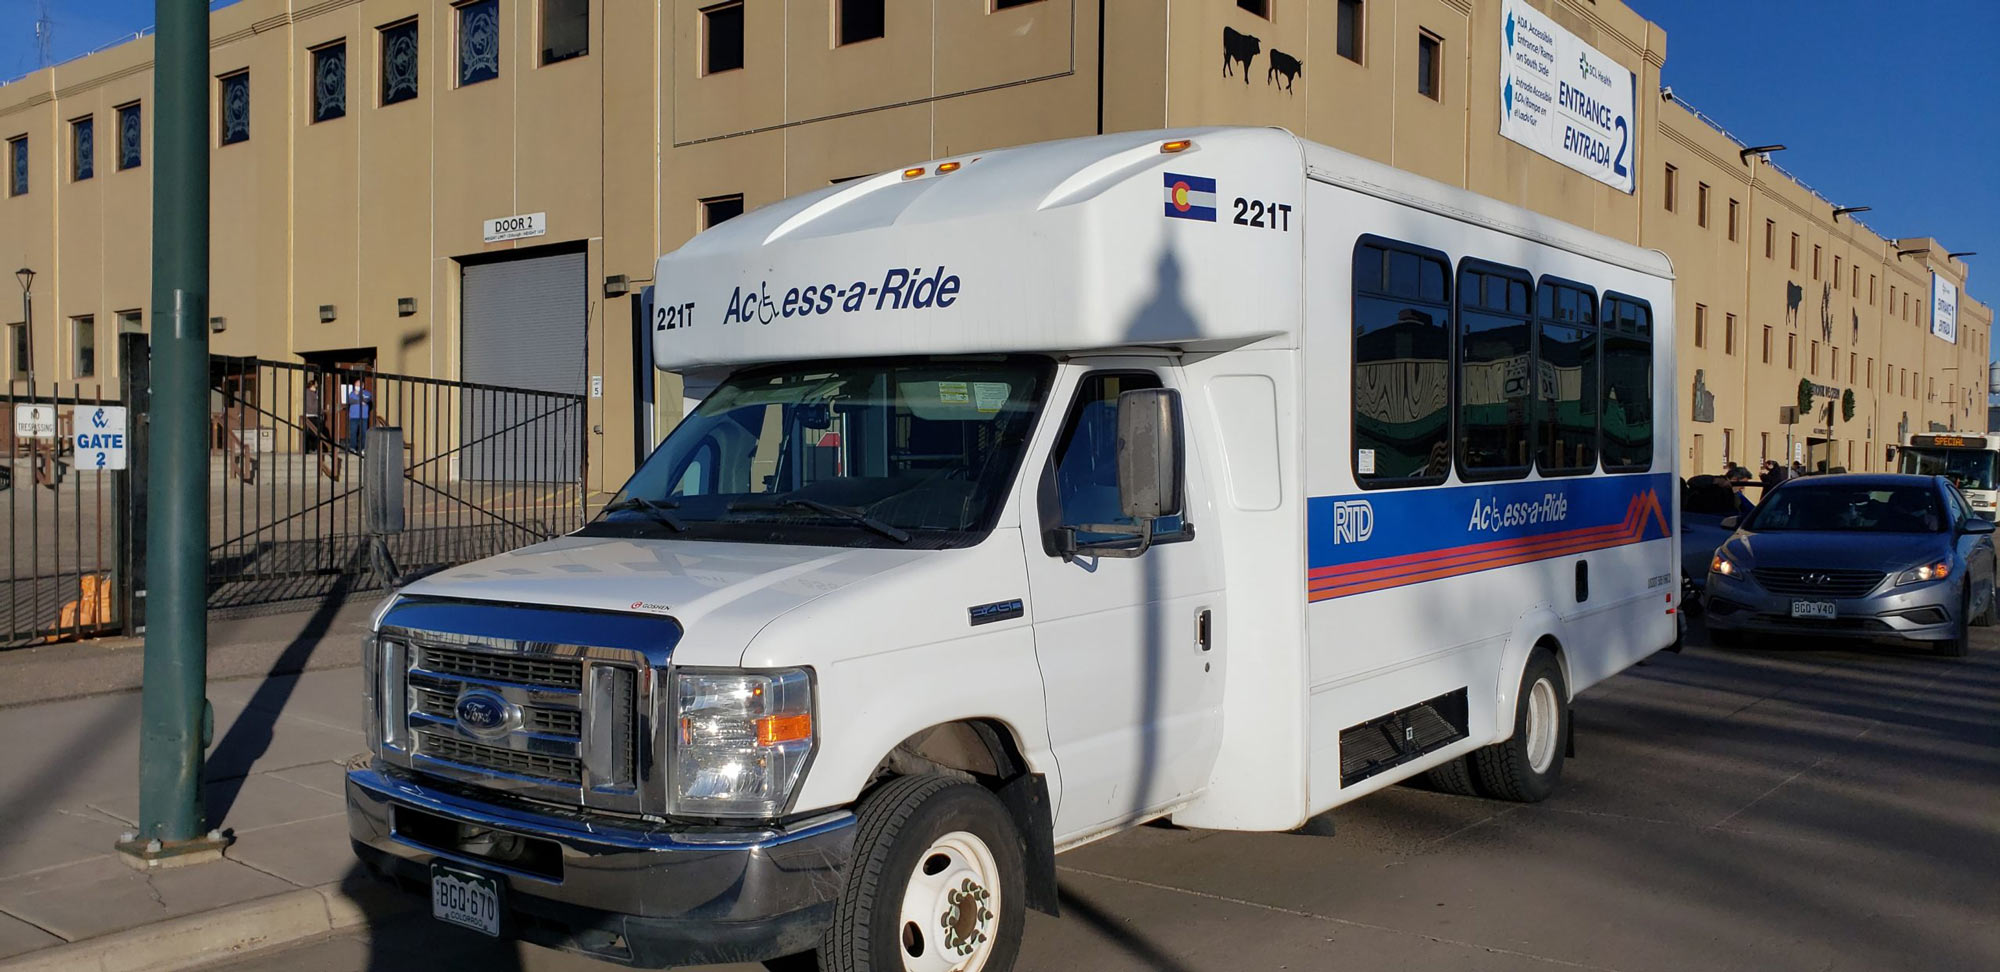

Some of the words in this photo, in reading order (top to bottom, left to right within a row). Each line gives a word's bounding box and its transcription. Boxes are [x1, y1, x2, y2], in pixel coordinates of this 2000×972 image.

[1559, 80, 1611, 131] ENTRANCE
[1563, 125, 1610, 169] ENTRADA
[1614, 115, 1628, 178] 2
[495, 217, 525, 233] DOOR
[528, 216, 533, 228] 2
[1233, 197, 1292, 232] 221T
[657, 302, 695, 331] 221T
[77, 434, 123, 449] GATE
[1934, 437, 1965, 447] SPECIAL
[96, 452, 106, 466] 2
[1333, 499, 1374, 545] RTD
[464, 702, 492, 723] Ford
[440, 882, 495, 921] BGQ-670
[450, 911, 483, 927] COLORADO
